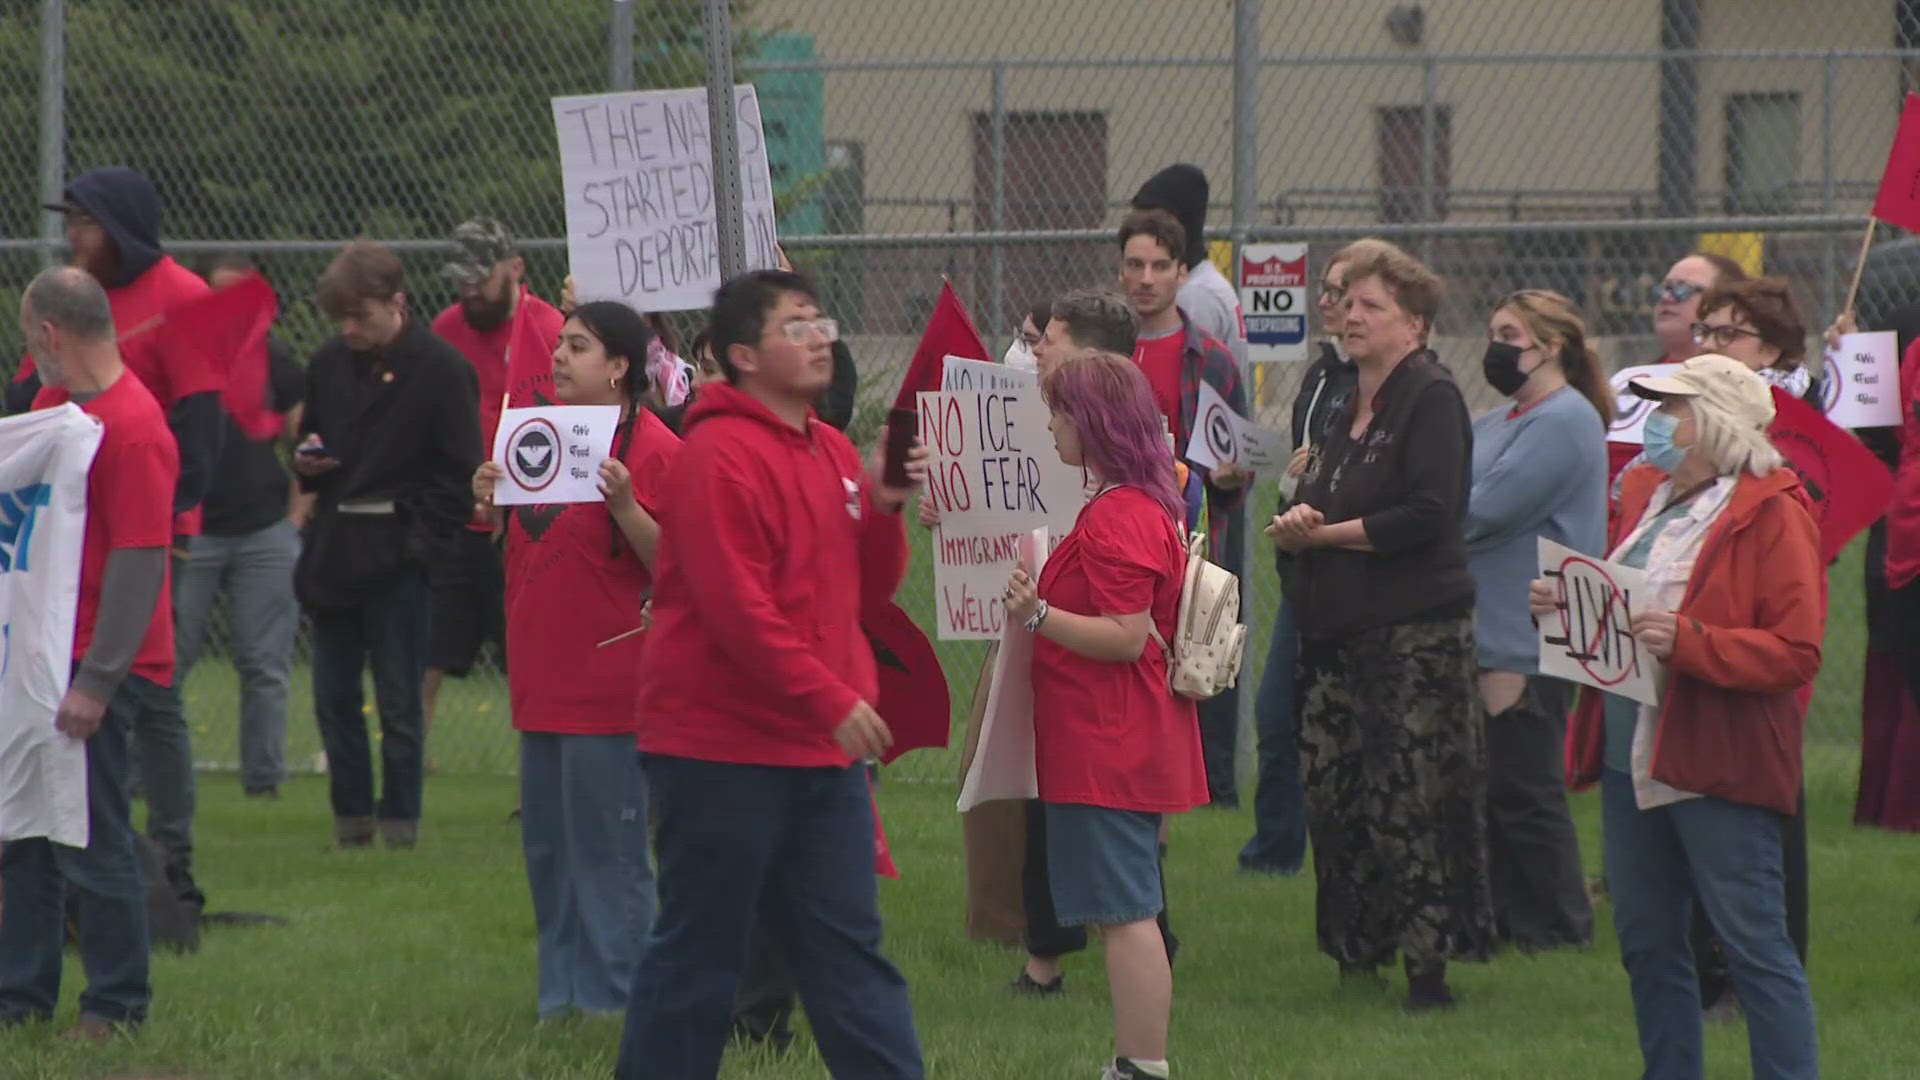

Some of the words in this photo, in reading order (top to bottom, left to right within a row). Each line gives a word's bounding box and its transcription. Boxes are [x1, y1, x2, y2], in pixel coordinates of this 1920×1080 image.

[565, 102, 657, 169] THE
[663, 94, 760, 159] NAS
[583, 161, 711, 238] STARTED
[615, 208, 778, 297] DEPORTAON
[1253, 289, 1293, 312] NO
[922, 396, 964, 457] NO
[977, 393, 1022, 453] ICE
[927, 460, 972, 513] NO
[982, 457, 1048, 513] FEAR
